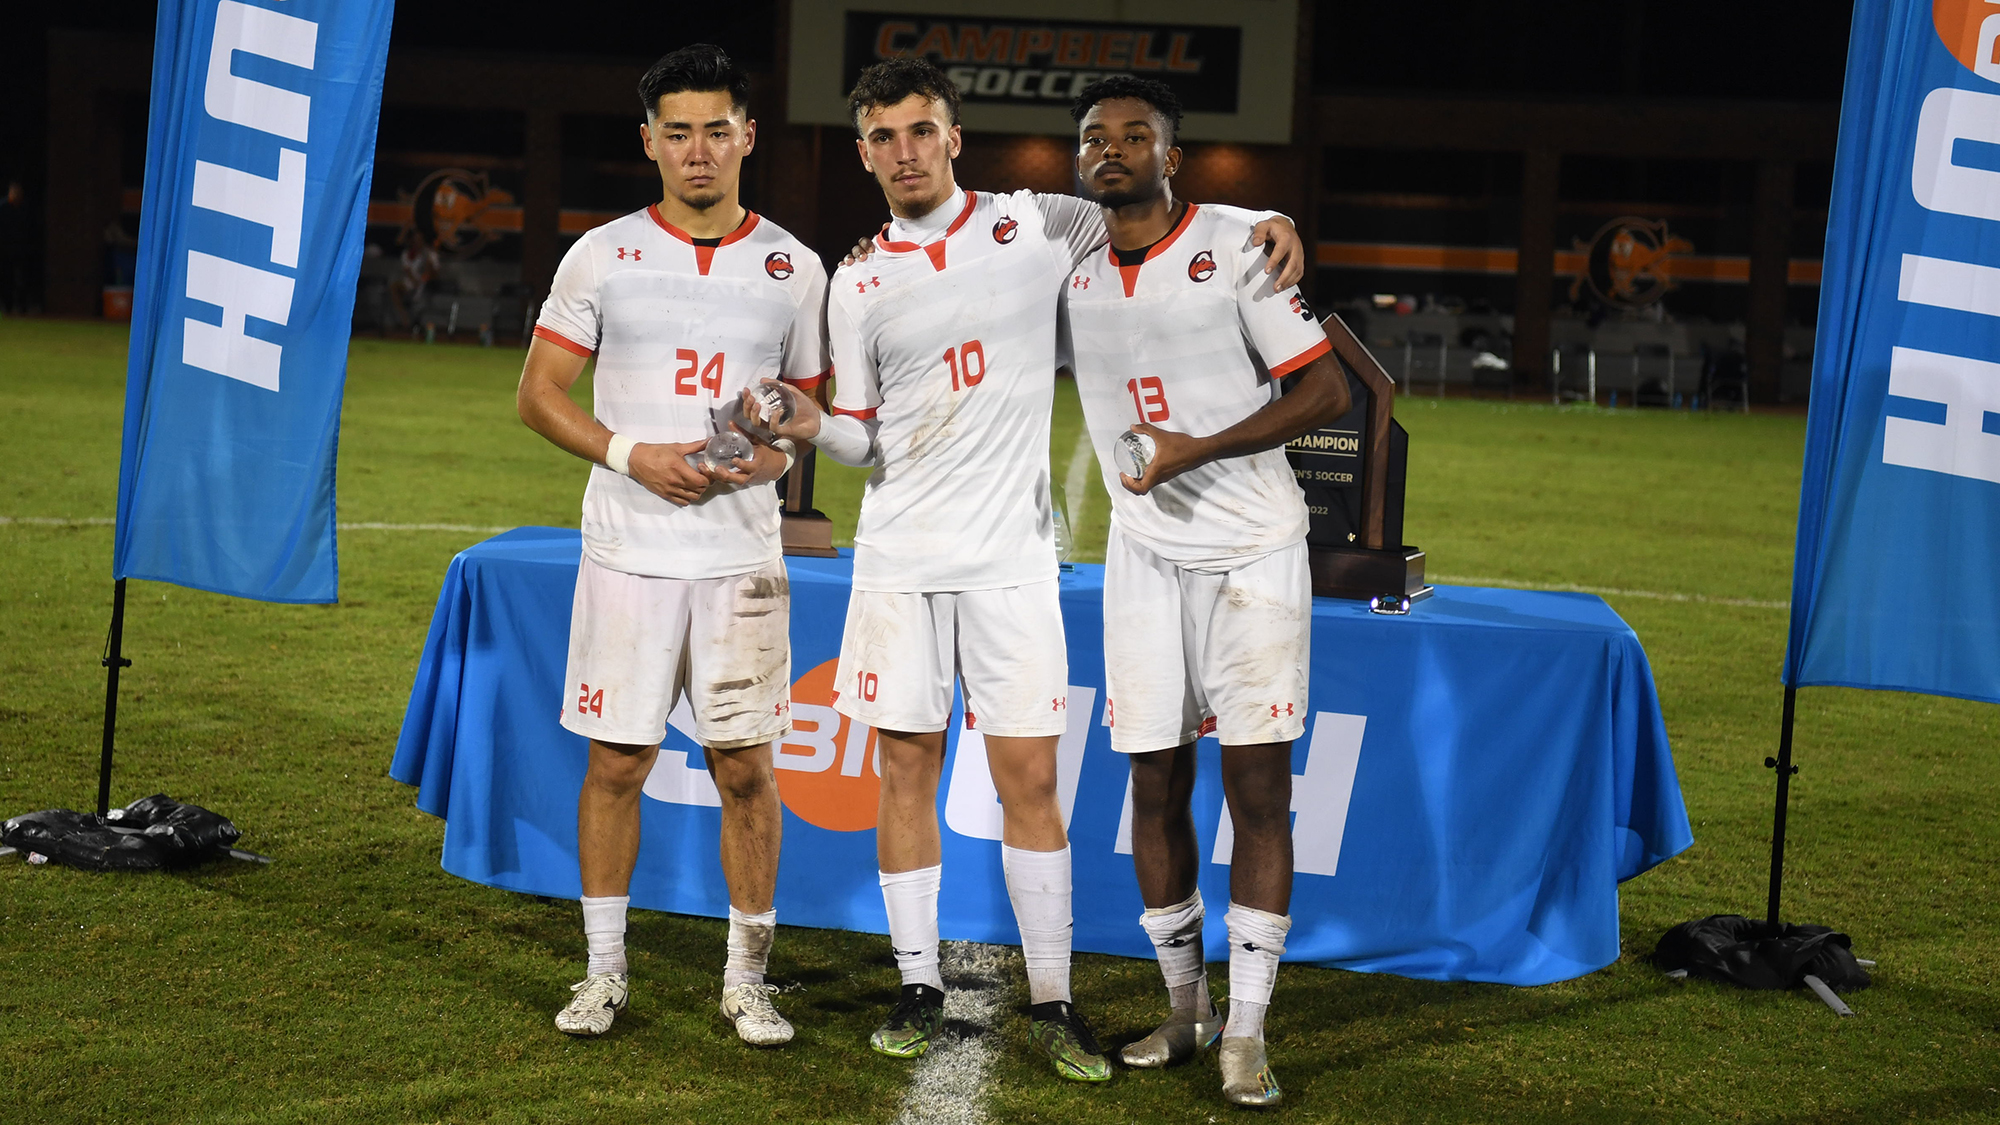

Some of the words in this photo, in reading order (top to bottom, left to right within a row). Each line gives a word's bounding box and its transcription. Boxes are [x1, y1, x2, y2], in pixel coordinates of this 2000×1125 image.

[875, 21, 1203, 73] CAMPBELL
[945, 66, 1134, 99] SOCCE
[675, 348, 725, 398] 24
[942, 339, 986, 392] 10
[1127, 376, 1170, 423] 13
[1293, 469, 1312, 480] EN'S
[1315, 471, 1354, 483] SOCCER
[1308, 505, 1328, 515] 022
[578, 683, 604, 719] 24
[857, 671, 878, 702] 10
[772, 702, 881, 778] BI
